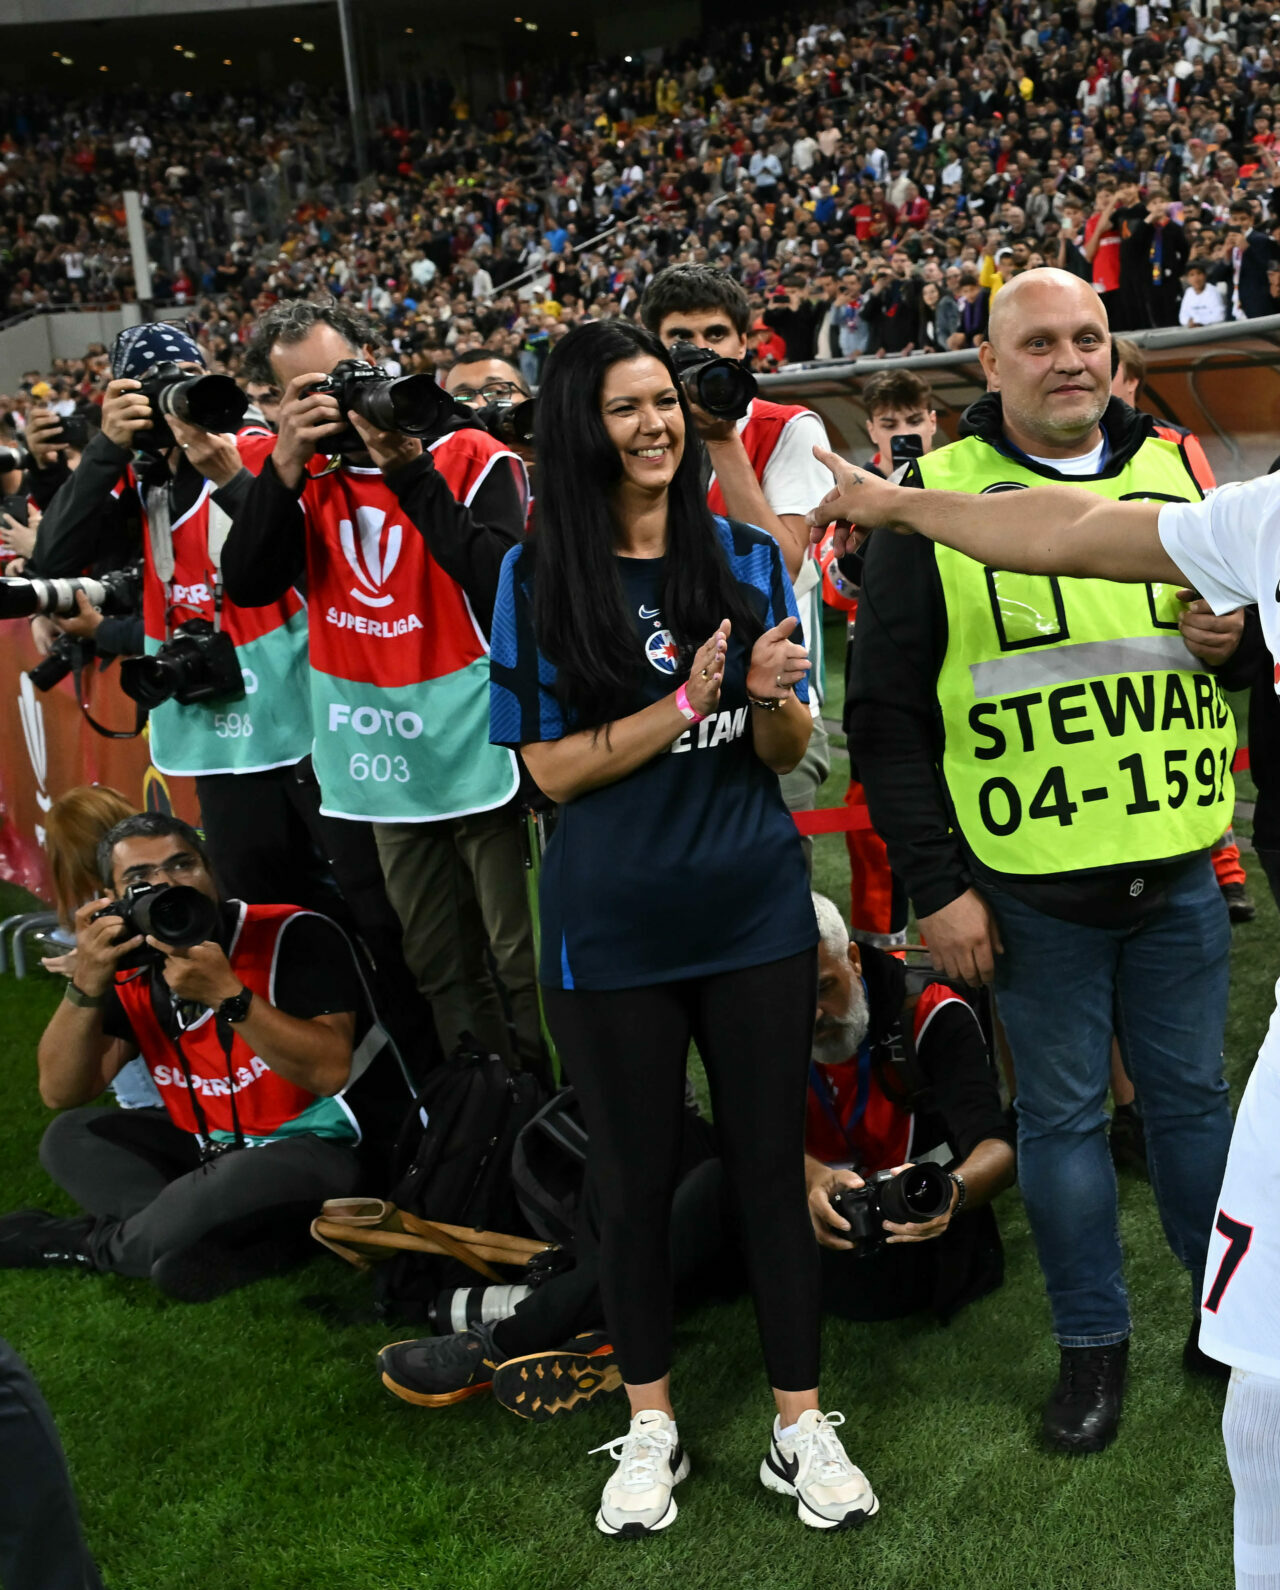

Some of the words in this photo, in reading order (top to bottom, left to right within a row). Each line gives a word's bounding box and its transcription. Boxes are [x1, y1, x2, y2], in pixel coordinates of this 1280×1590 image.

[215, 713, 253, 738] 598
[328, 703, 423, 739] FOTO
[968, 674, 1228, 760] STEWARD
[350, 753, 410, 783] 603
[1202, 1208, 1254, 1315] 7
